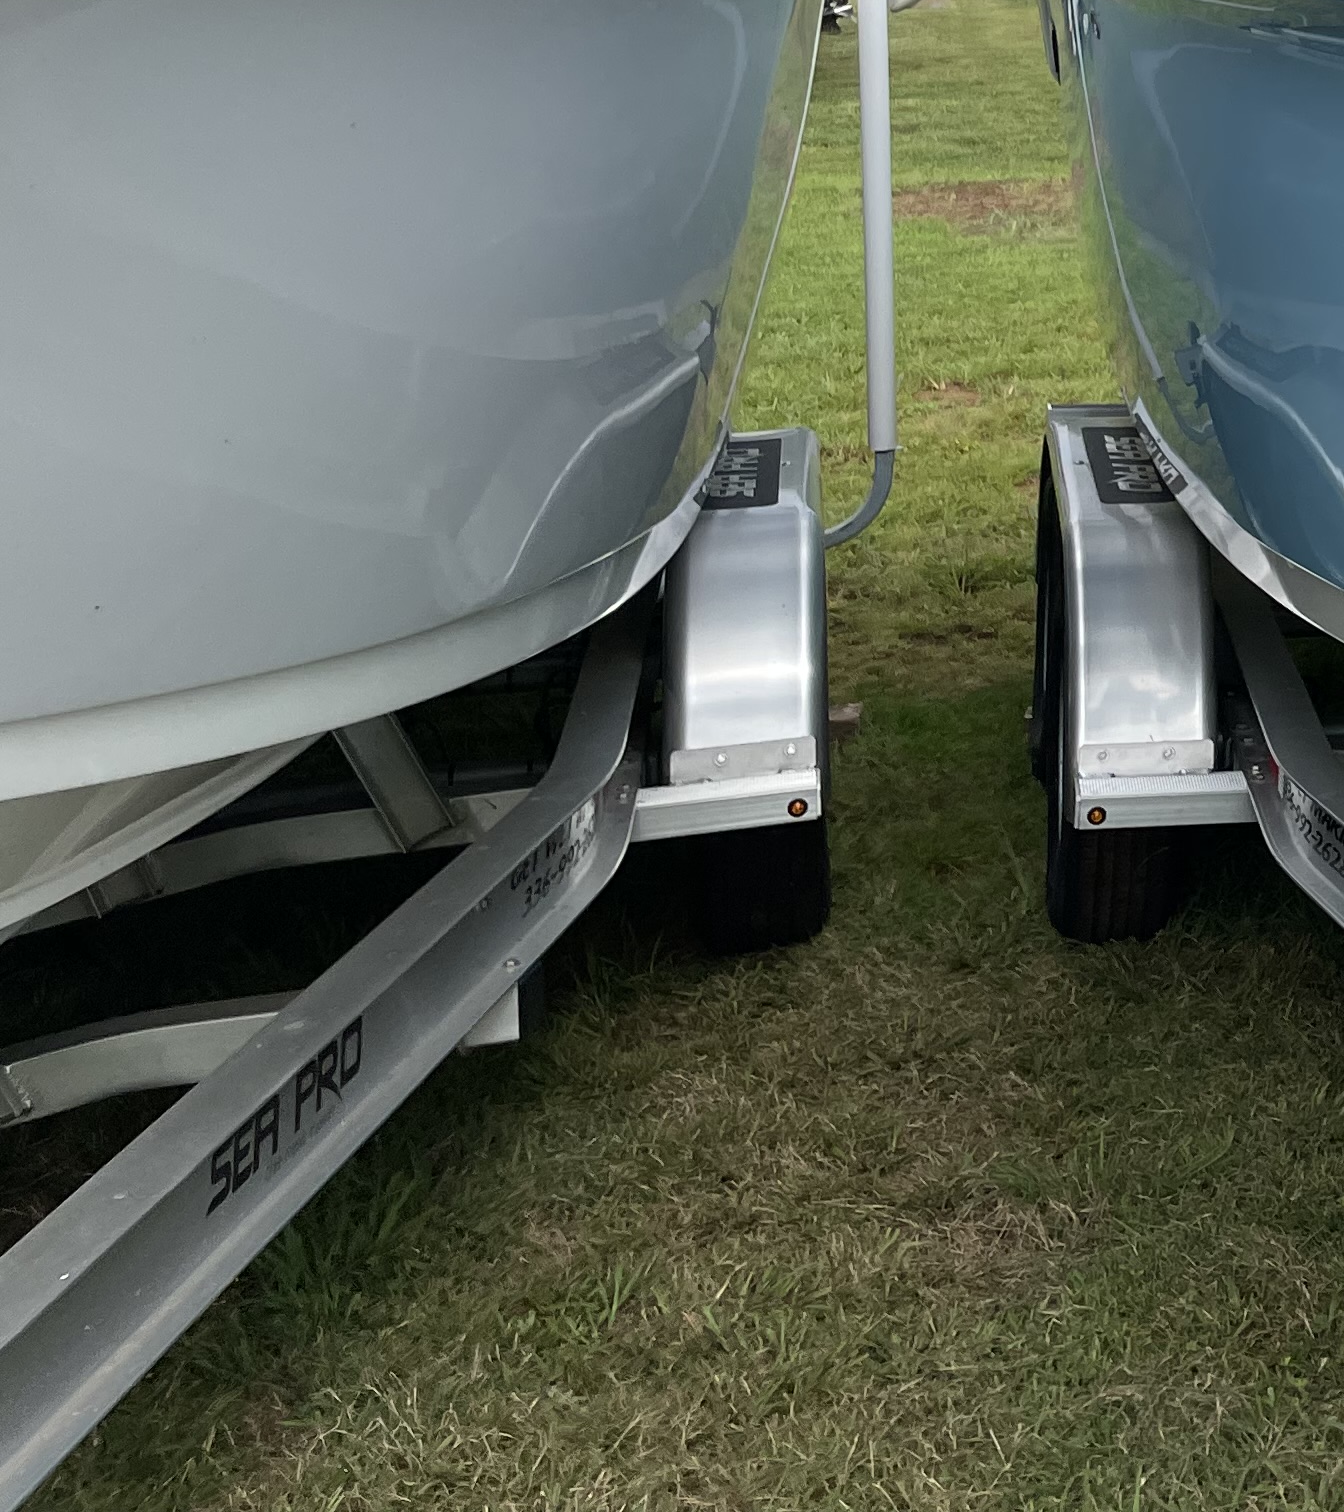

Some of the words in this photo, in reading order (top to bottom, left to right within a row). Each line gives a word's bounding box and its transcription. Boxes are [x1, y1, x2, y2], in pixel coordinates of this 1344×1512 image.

[1103, 435, 1150, 460] SEA
[1108, 462, 1163, 492] PRO
[206, 1094, 280, 1218] SEA
[295, 1015, 363, 1134] PRO
